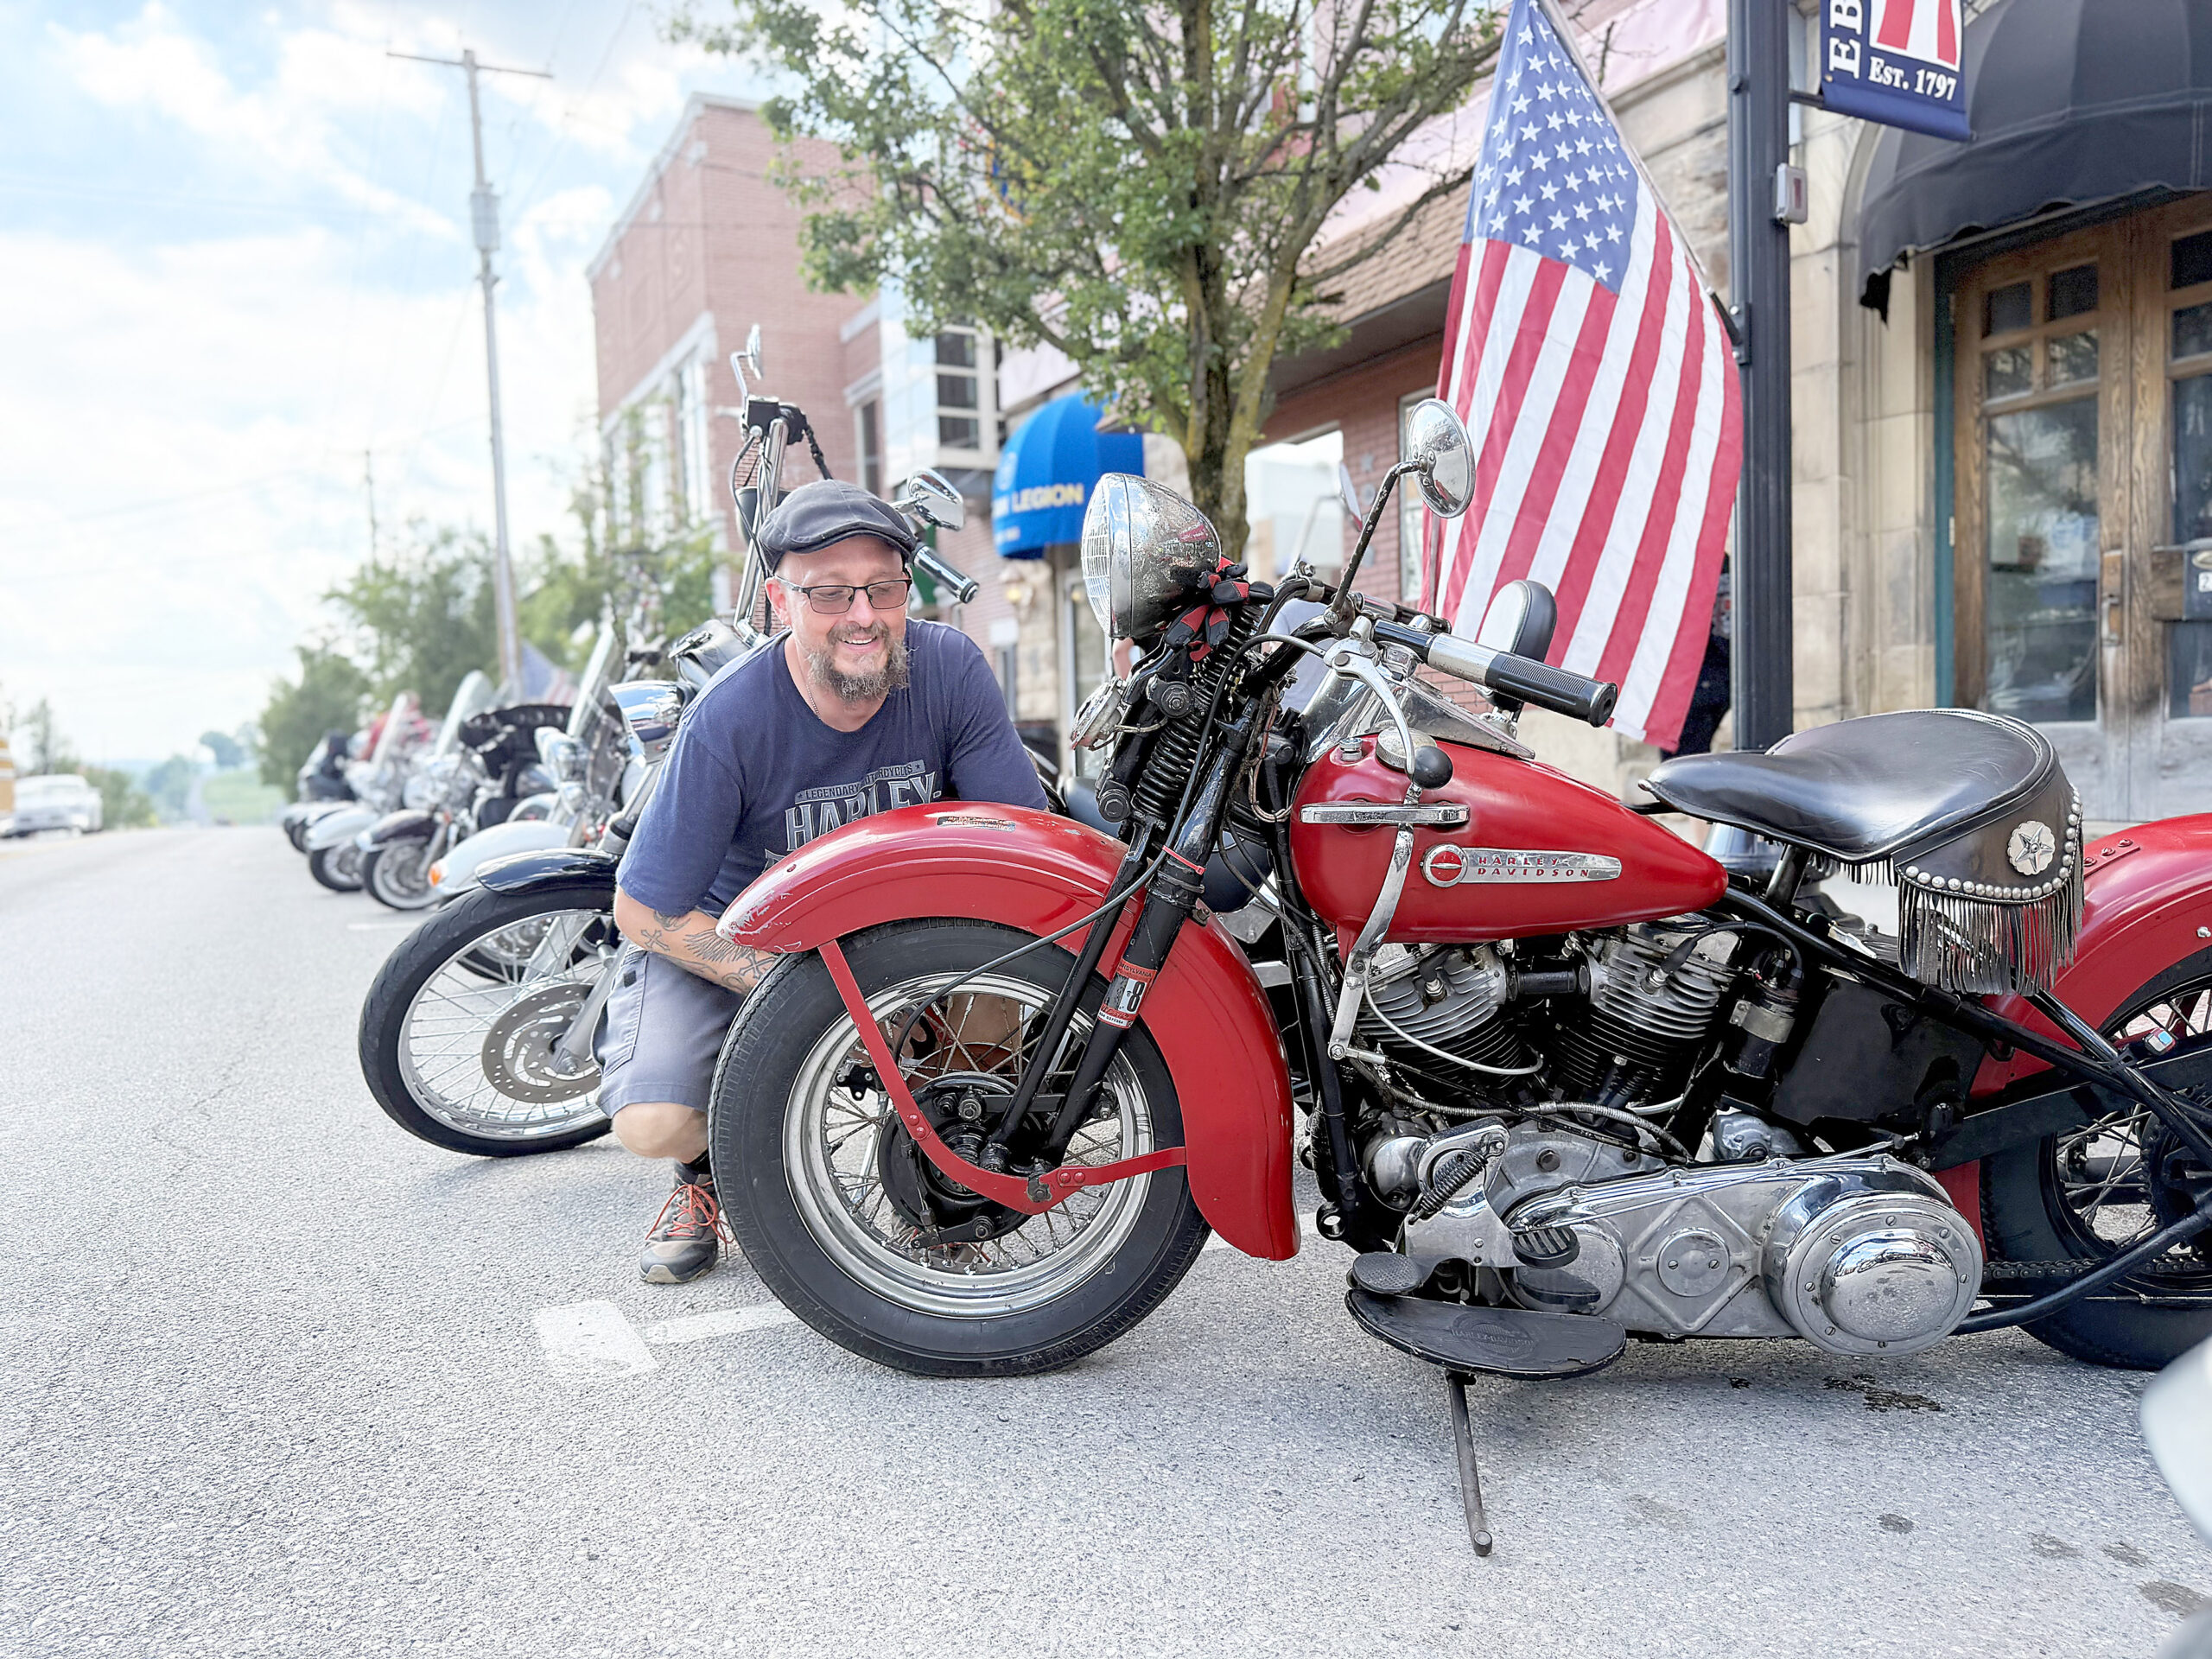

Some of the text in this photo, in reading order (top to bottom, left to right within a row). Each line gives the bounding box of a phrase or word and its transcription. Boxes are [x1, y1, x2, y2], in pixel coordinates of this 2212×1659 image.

[1915, 68, 1956, 101] 1797
[1012, 483, 1084, 512] LEGION
[805, 783, 860, 799] LEGENDARY
[1477, 868, 1589, 877] DAVIDSON
[1127, 981, 1146, 1012] 8
